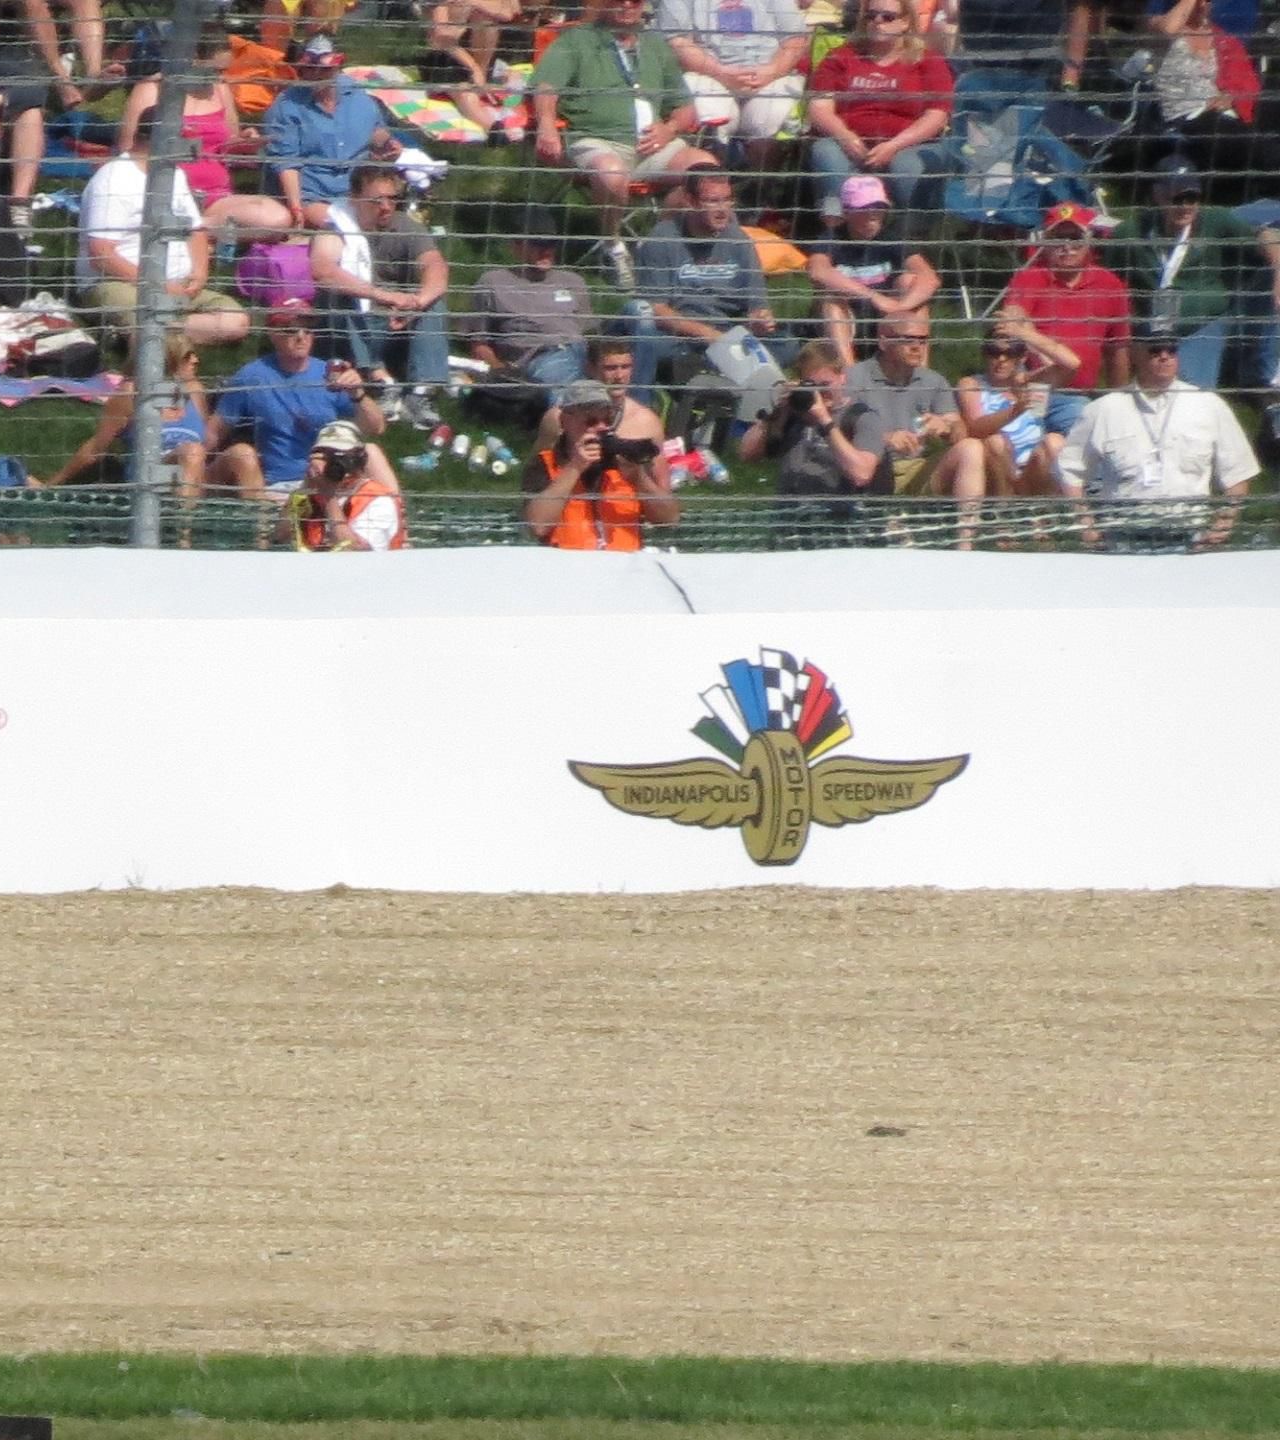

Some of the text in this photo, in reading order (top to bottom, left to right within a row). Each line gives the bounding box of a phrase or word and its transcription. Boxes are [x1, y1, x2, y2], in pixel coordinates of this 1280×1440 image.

[623, 784, 751, 805] INDIANAPOLIS
[780, 748, 806, 847] MOTOR
[823, 783, 915, 801] SPEEDWAY
